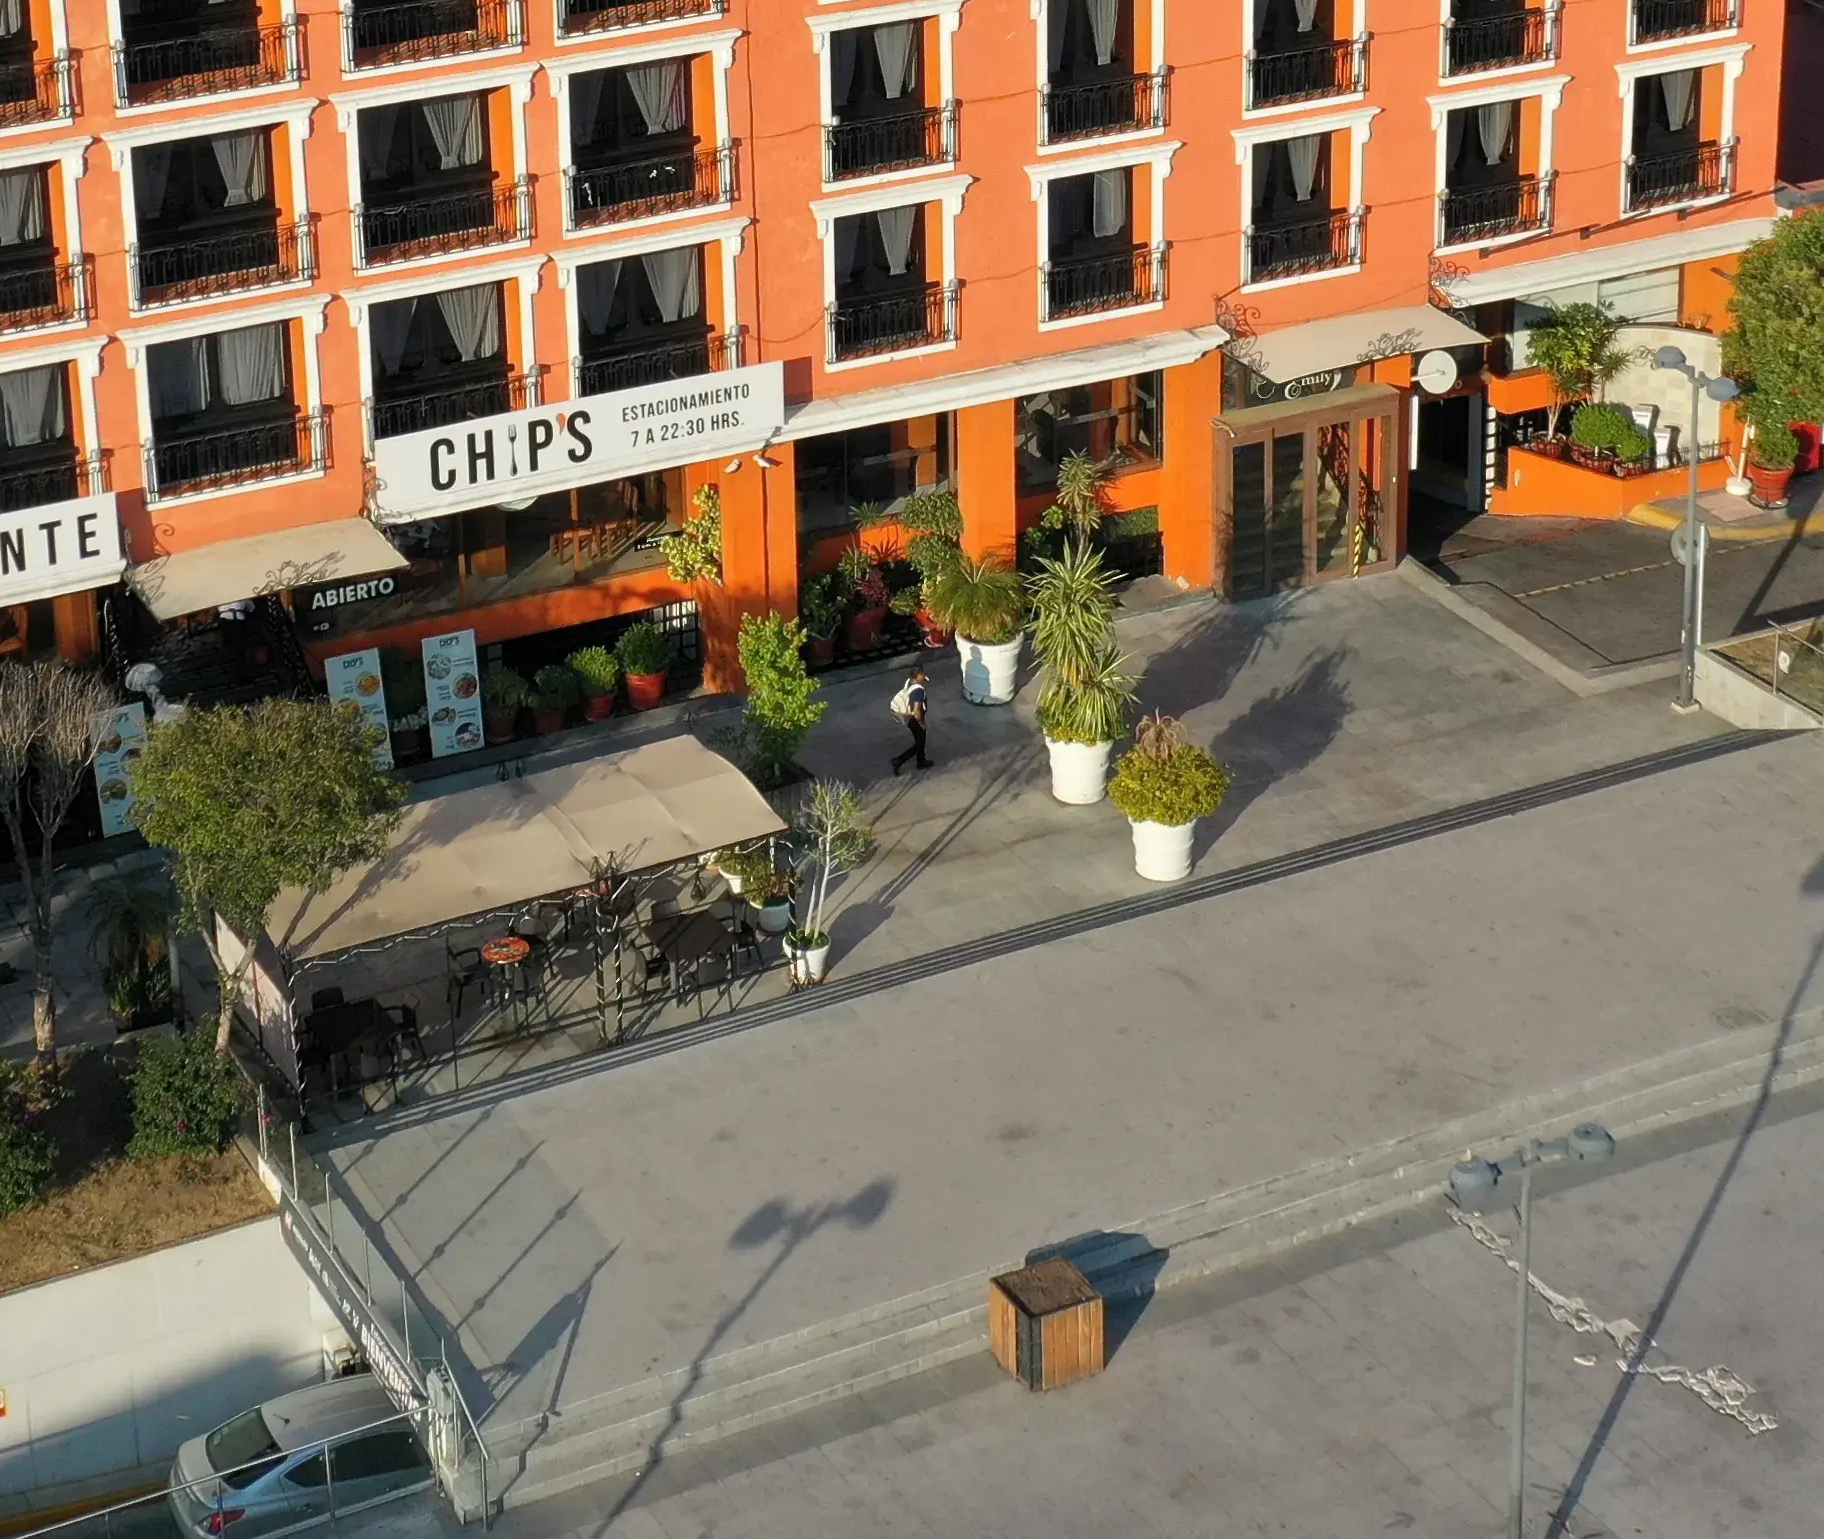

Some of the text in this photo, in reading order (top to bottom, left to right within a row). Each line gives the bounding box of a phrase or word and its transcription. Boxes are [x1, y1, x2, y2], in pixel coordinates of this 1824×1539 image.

[429, 383, 751, 492] CHIP'S ESTACIONAMIENTO
[630, 410, 746, 448] 7 A 22:30 HRS.
[311, 577, 395, 610] ABIERTO
